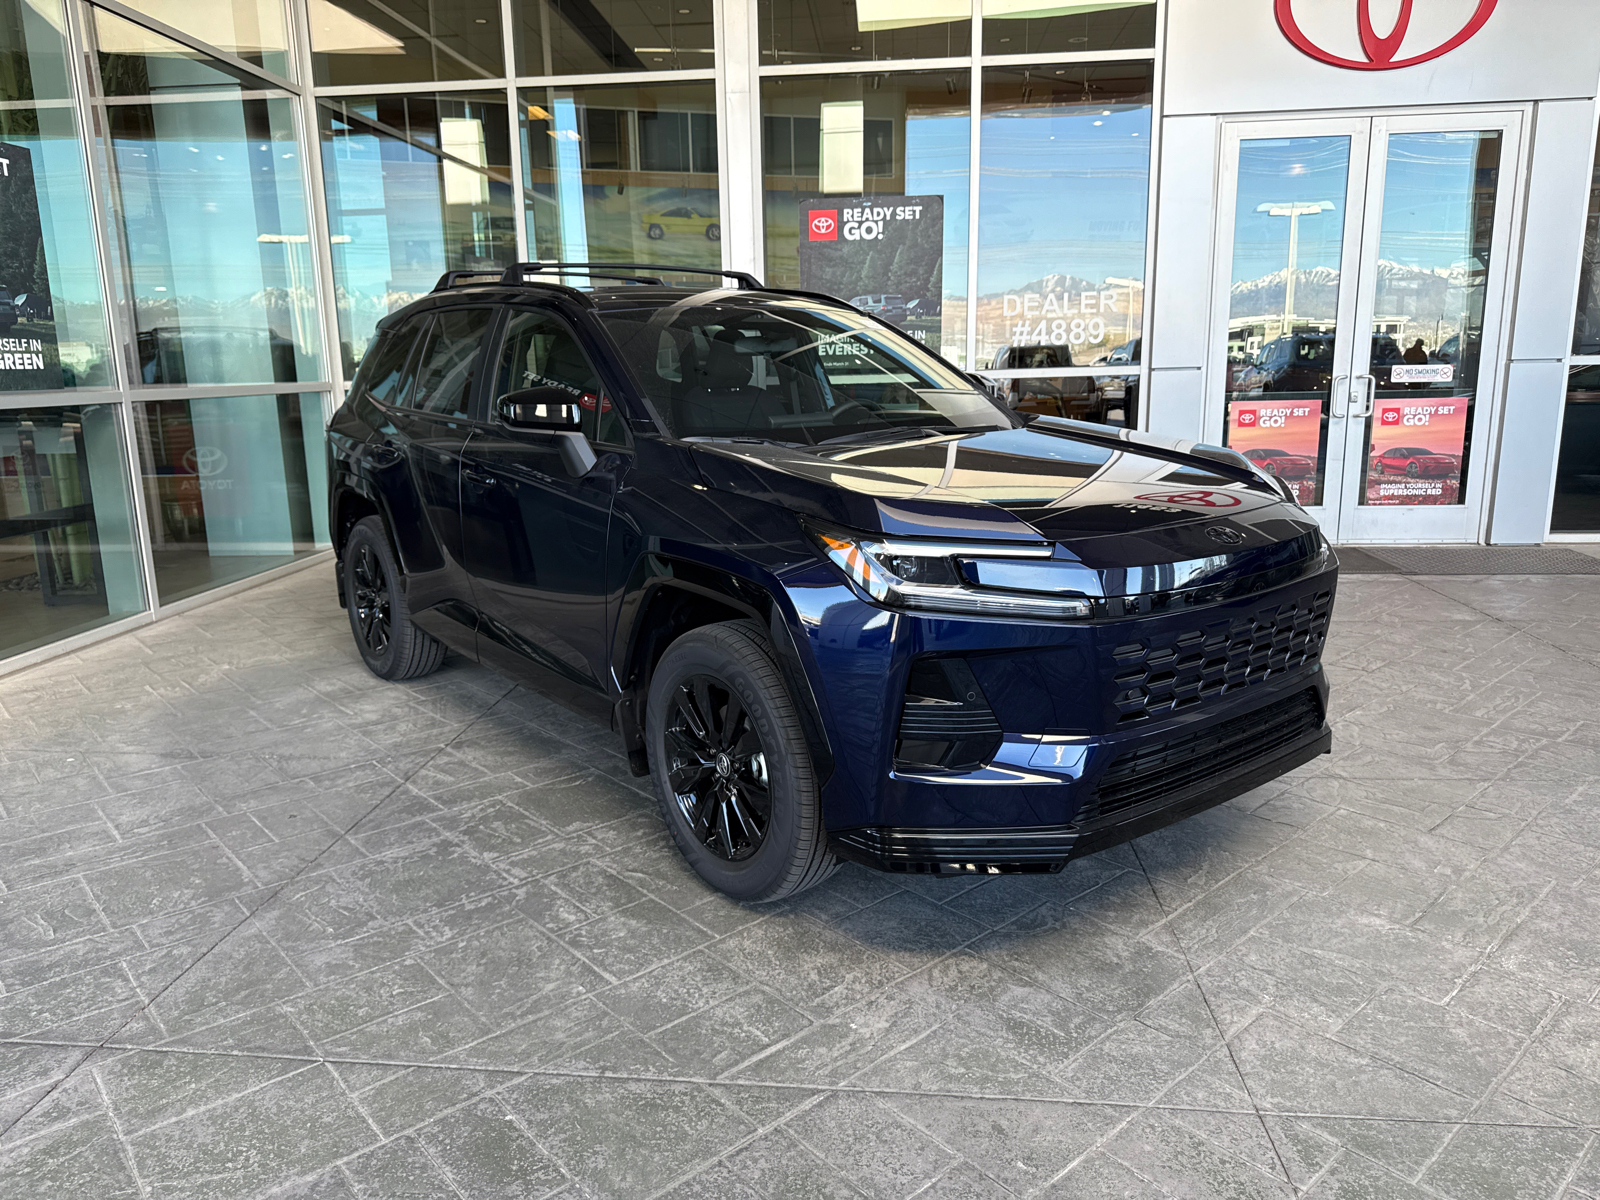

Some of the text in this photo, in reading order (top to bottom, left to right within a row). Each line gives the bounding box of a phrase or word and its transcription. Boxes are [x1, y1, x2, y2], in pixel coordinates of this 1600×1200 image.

[843, 206, 922, 222] READY SET
[843, 221, 884, 241] GO!
[1003, 291, 1118, 317] DEALER
[1012, 317, 1105, 347] #4889
[30, 338, 42, 351] IN
[1260, 407, 1310, 417] READY SET
[1403, 405, 1456, 415] READY SET
[1259, 416, 1286, 428] GO!
[1403, 414, 1430, 426] GO!
[1380, 488, 1426, 496] SUPERSONIC
